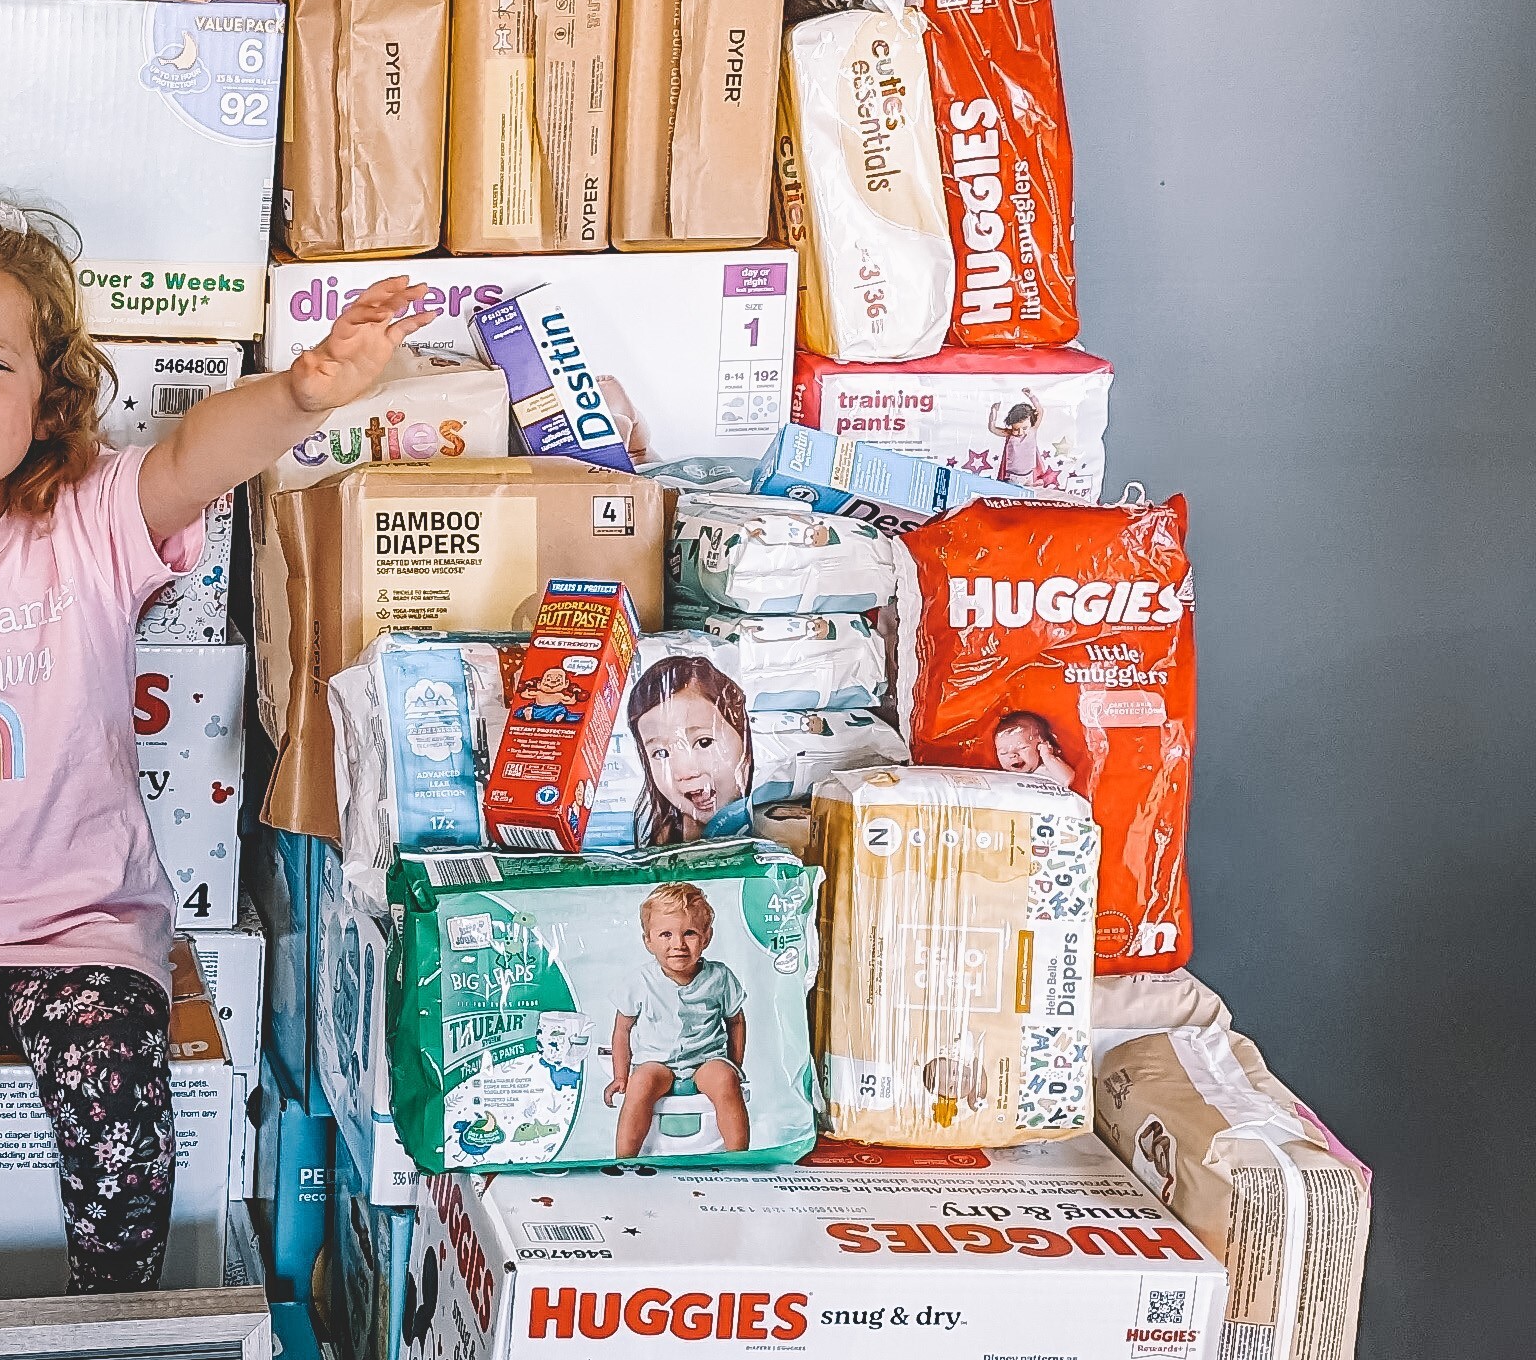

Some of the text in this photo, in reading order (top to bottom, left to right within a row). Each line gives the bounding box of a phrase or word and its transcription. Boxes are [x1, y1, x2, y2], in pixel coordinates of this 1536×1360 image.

[195, 16, 285, 34] VALUE PACK
[238, 38, 264, 73] 6
[220, 92, 269, 126] 92
[78, 269, 245, 293] Over 3 Weeks
[745, 302, 764, 311] SIZE
[753, 370, 779, 383] 192
[837, 390, 935, 412] training
[836, 414, 906, 435] pants
[292, 411, 465, 468] cuties
[602, 501, 617, 524] 4
[376, 533, 480, 556] DIAPERS
[1087, 645, 1139, 662] little
[1064, 662, 1168, 687] snugglers
[417, 770, 461, 781] ADVANCED
[415, 789, 466, 799] PROTECTION
[770, 935, 786, 950] 19
[1057, 932, 1079, 1017] Diapers
[28, 1151, 44, 1160] and
[527, 1287, 809, 1341] HUGGIES
[820, 1305, 962, 1331] snug & dry
